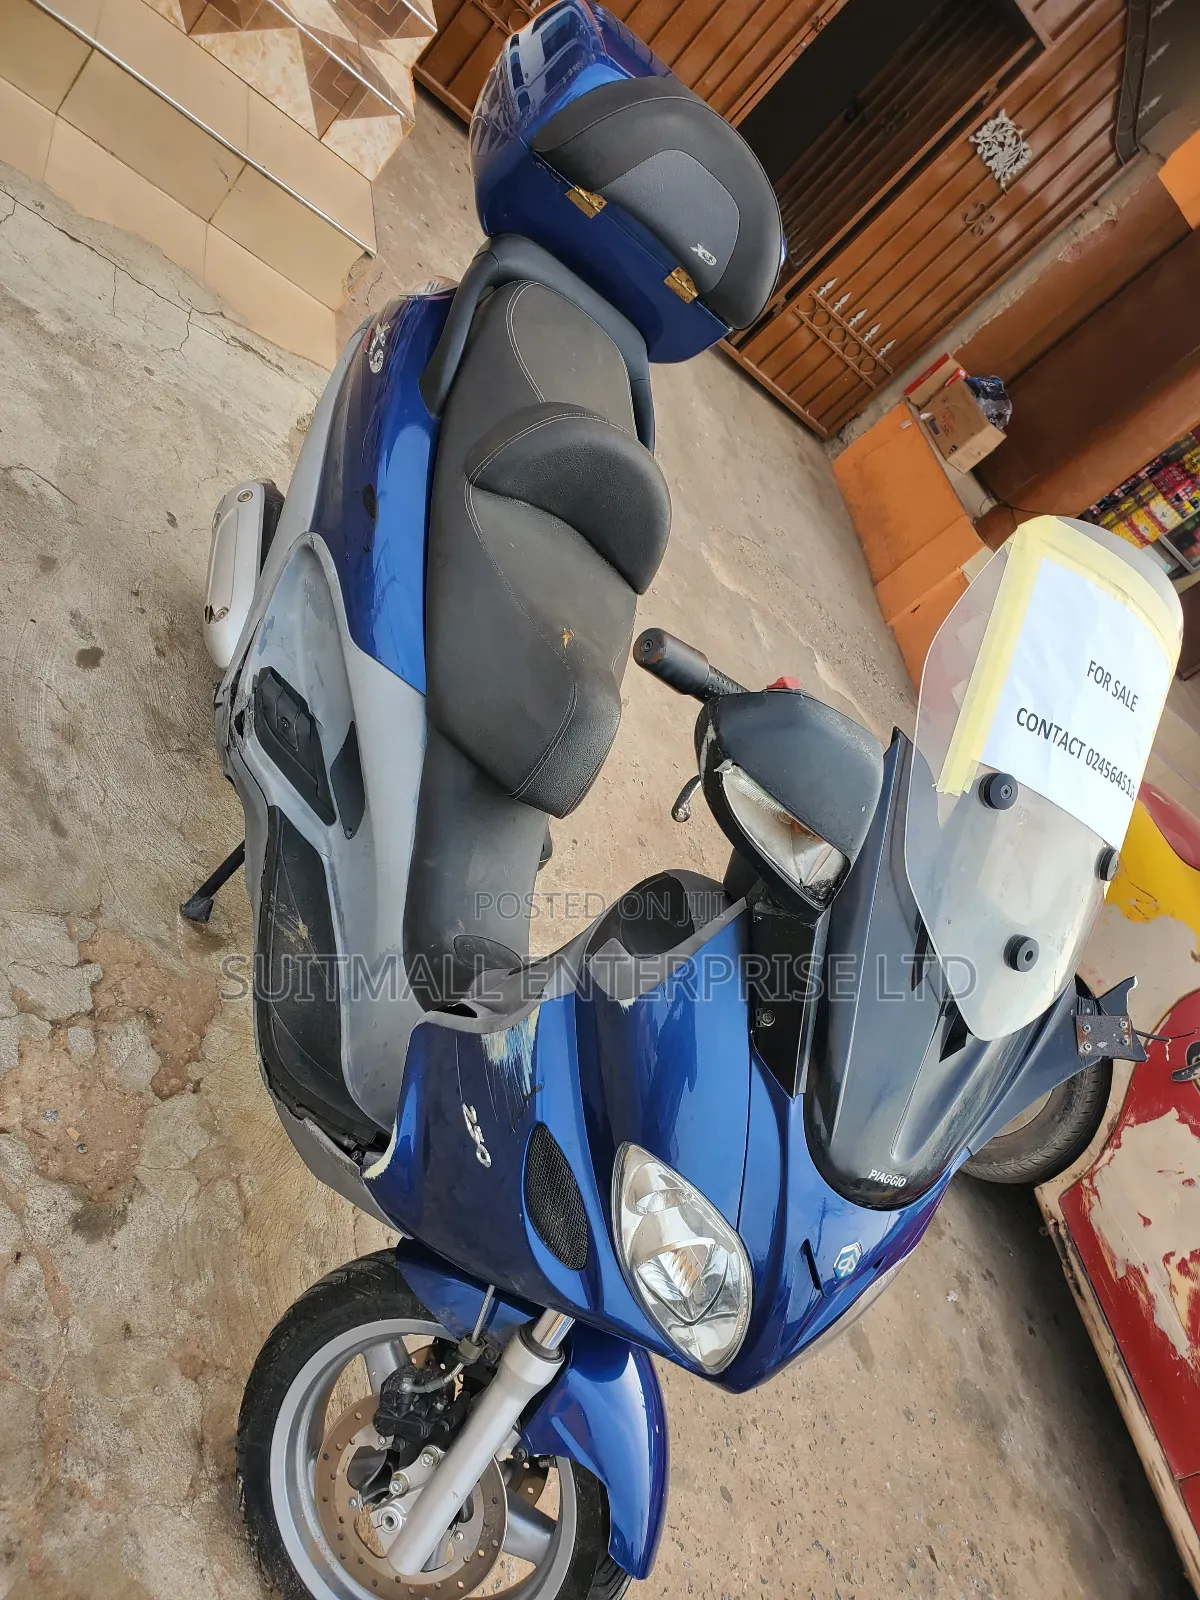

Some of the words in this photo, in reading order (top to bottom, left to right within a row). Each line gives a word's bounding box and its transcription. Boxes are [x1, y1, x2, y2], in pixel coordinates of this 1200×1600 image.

[1087, 660, 1112, 692] FOR
[1111, 680, 1139, 713] SALE
[1016, 707, 1087, 760] CONTACT
[867, 1168, 907, 1188] PIAGGIO
